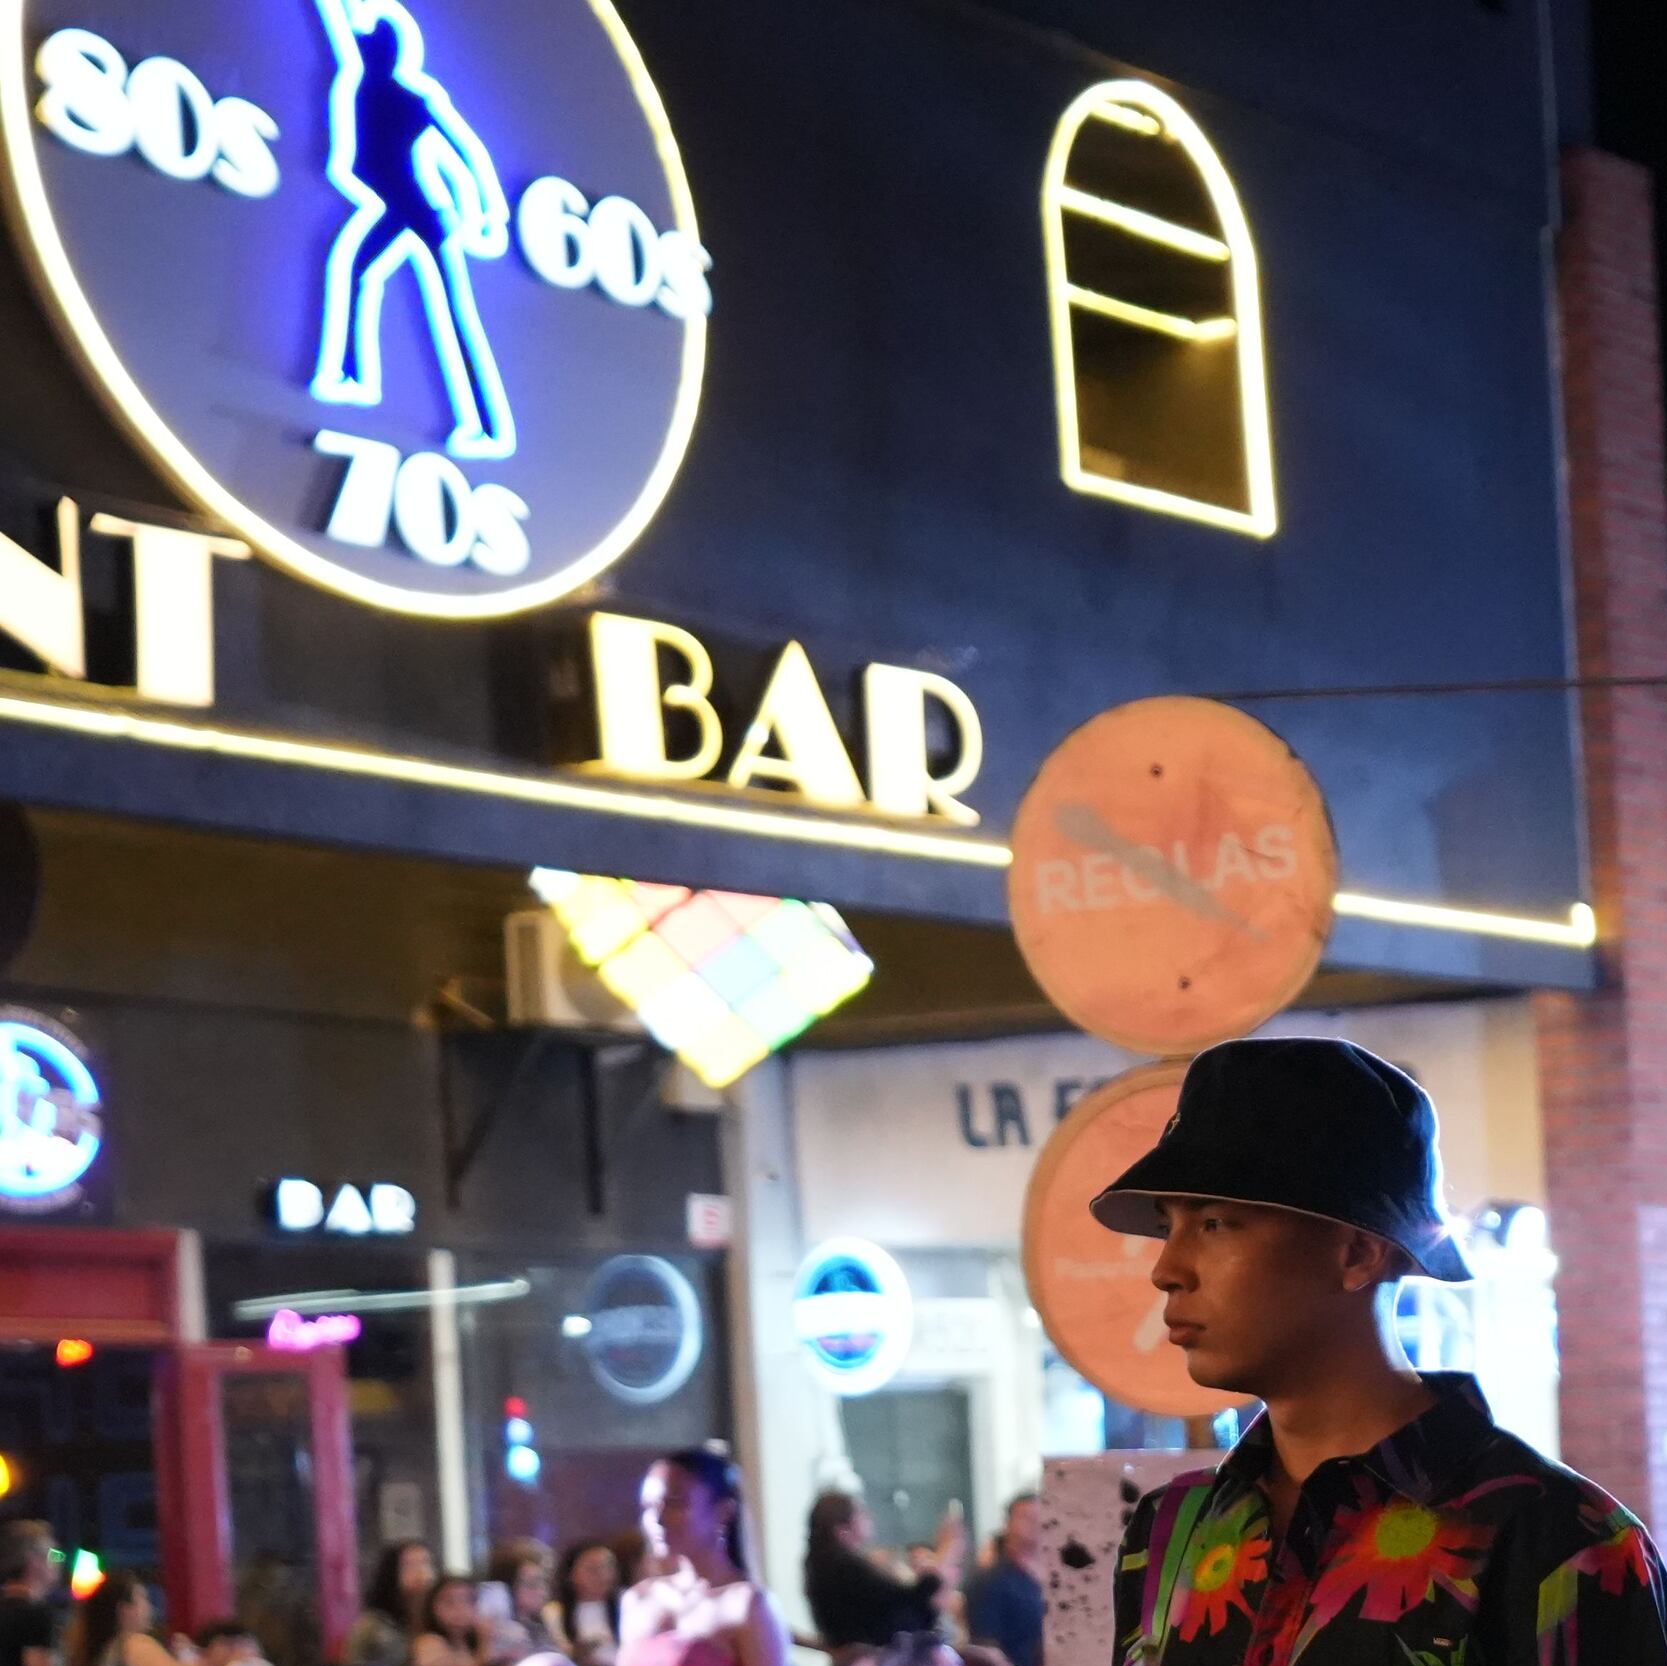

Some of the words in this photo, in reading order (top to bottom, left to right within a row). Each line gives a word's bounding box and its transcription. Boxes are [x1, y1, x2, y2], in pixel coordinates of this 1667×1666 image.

[35, 28, 281, 198] 80s
[517, 176, 714, 321] 60s
[313, 429, 532, 576] 70s
[589, 611, 984, 828] BAR
[277, 1178, 417, 1236] BAR
